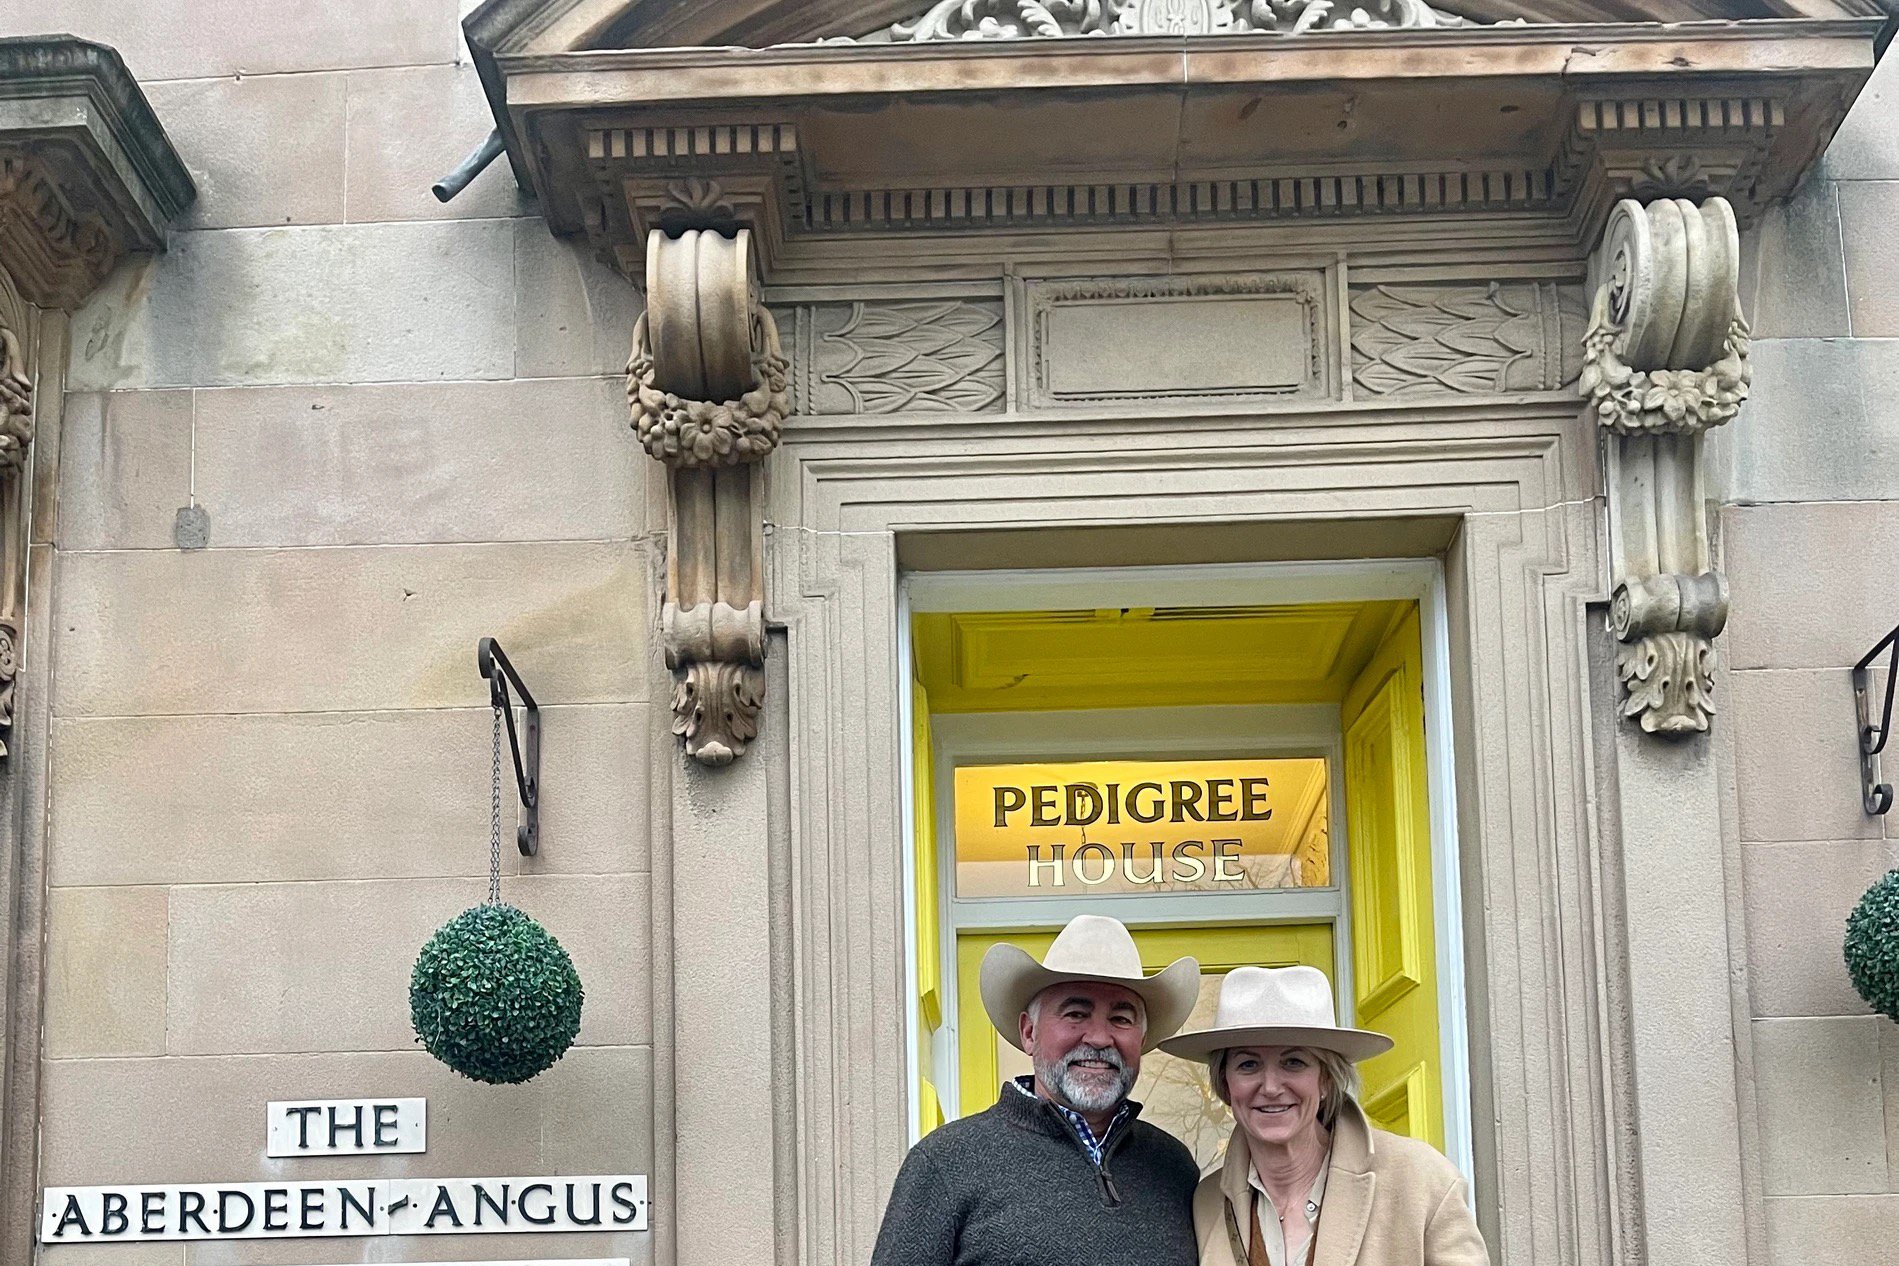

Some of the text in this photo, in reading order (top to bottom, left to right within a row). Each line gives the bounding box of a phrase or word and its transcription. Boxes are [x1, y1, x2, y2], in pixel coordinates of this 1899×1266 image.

[993, 777, 1273, 828] PEDIGREE
[1026, 838, 1246, 888] HOUSE
[285, 1104, 400, 1150] THE
